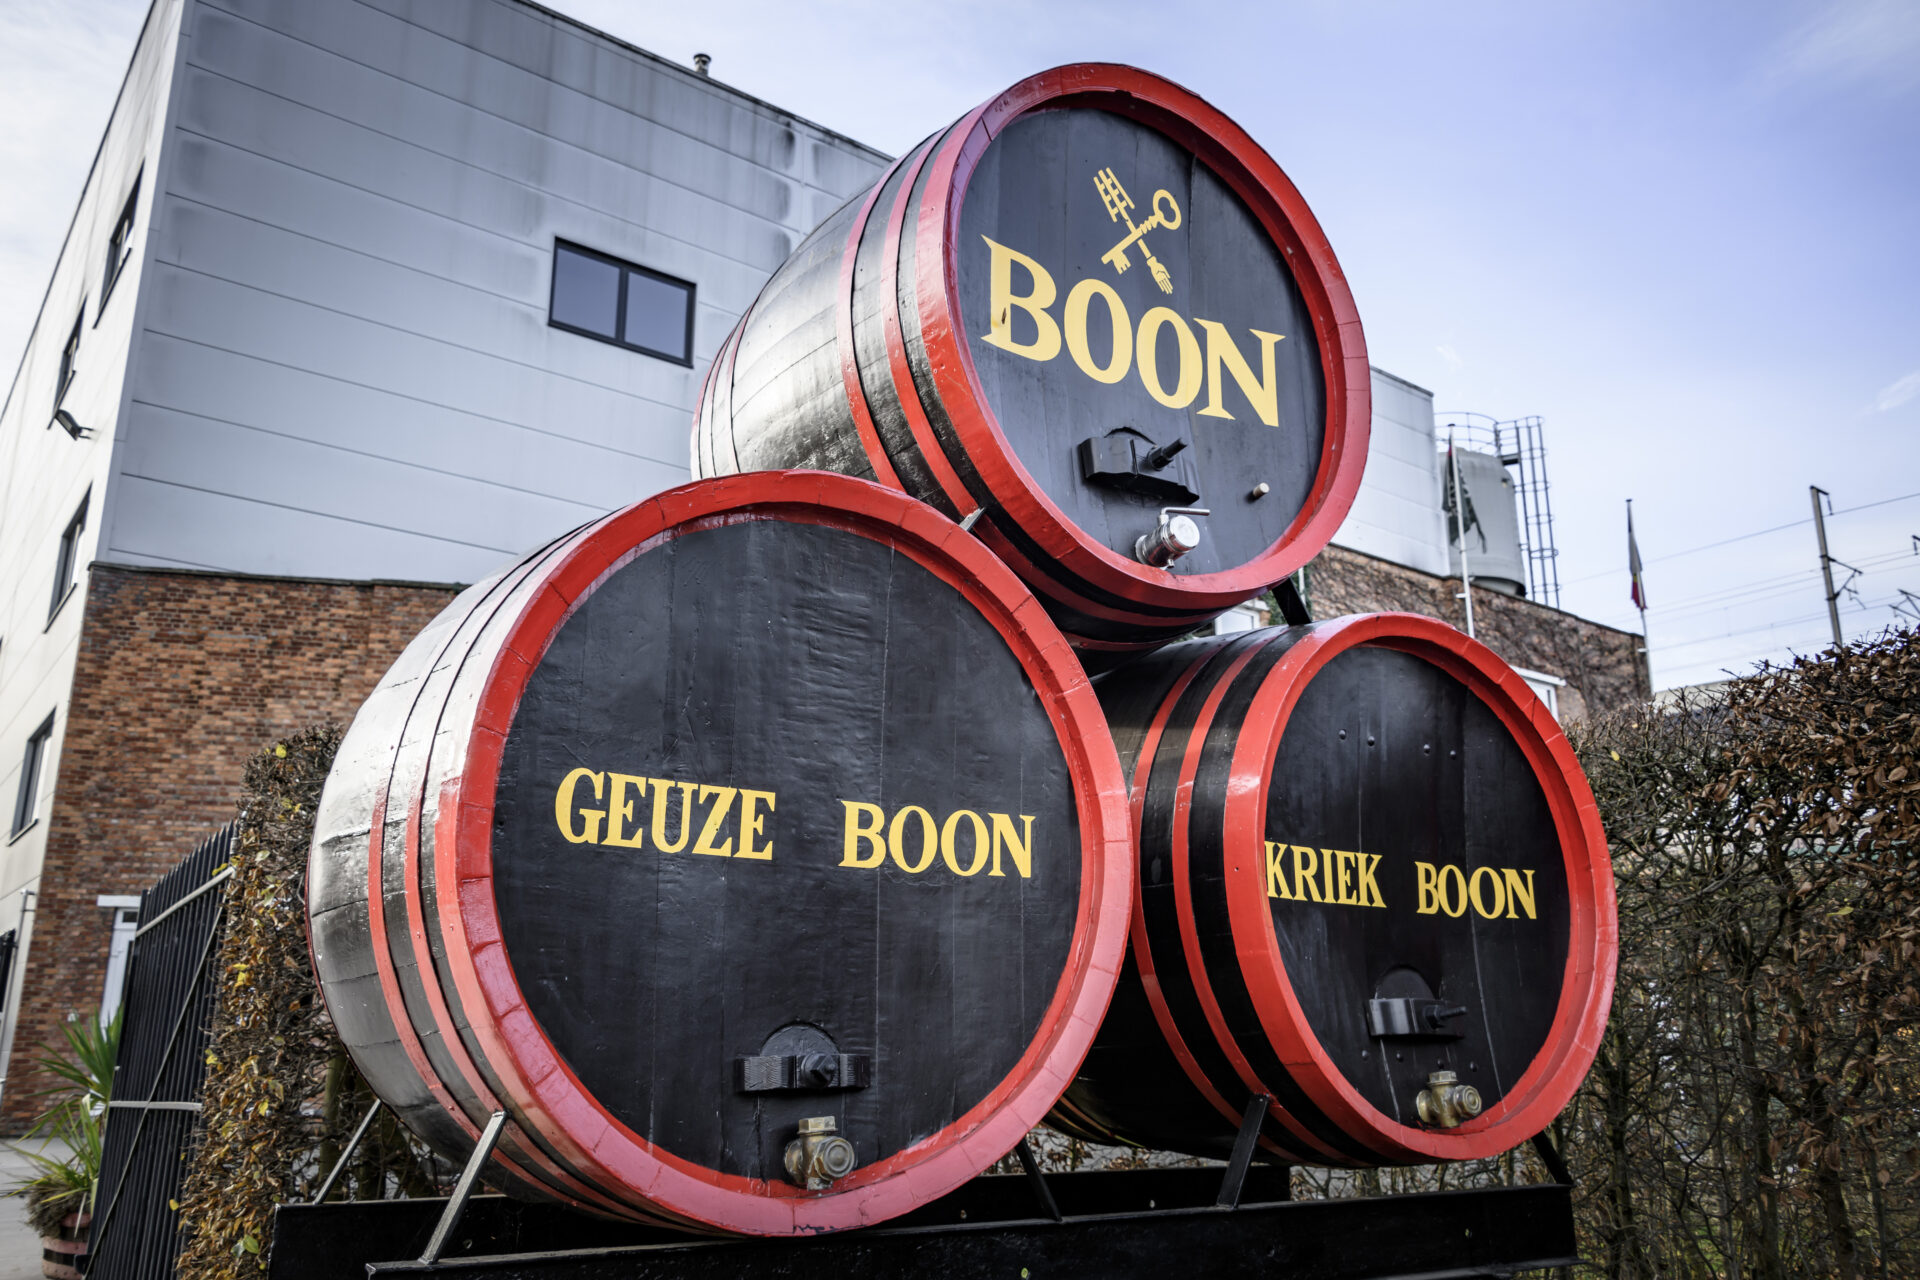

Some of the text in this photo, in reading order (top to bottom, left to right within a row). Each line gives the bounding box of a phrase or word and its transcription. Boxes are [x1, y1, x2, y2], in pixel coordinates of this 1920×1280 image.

[981, 235, 1286, 427] BOON
[555, 768, 1036, 878] GEUZE BOON
[1265, 841, 1537, 920] KRIEK BOON
